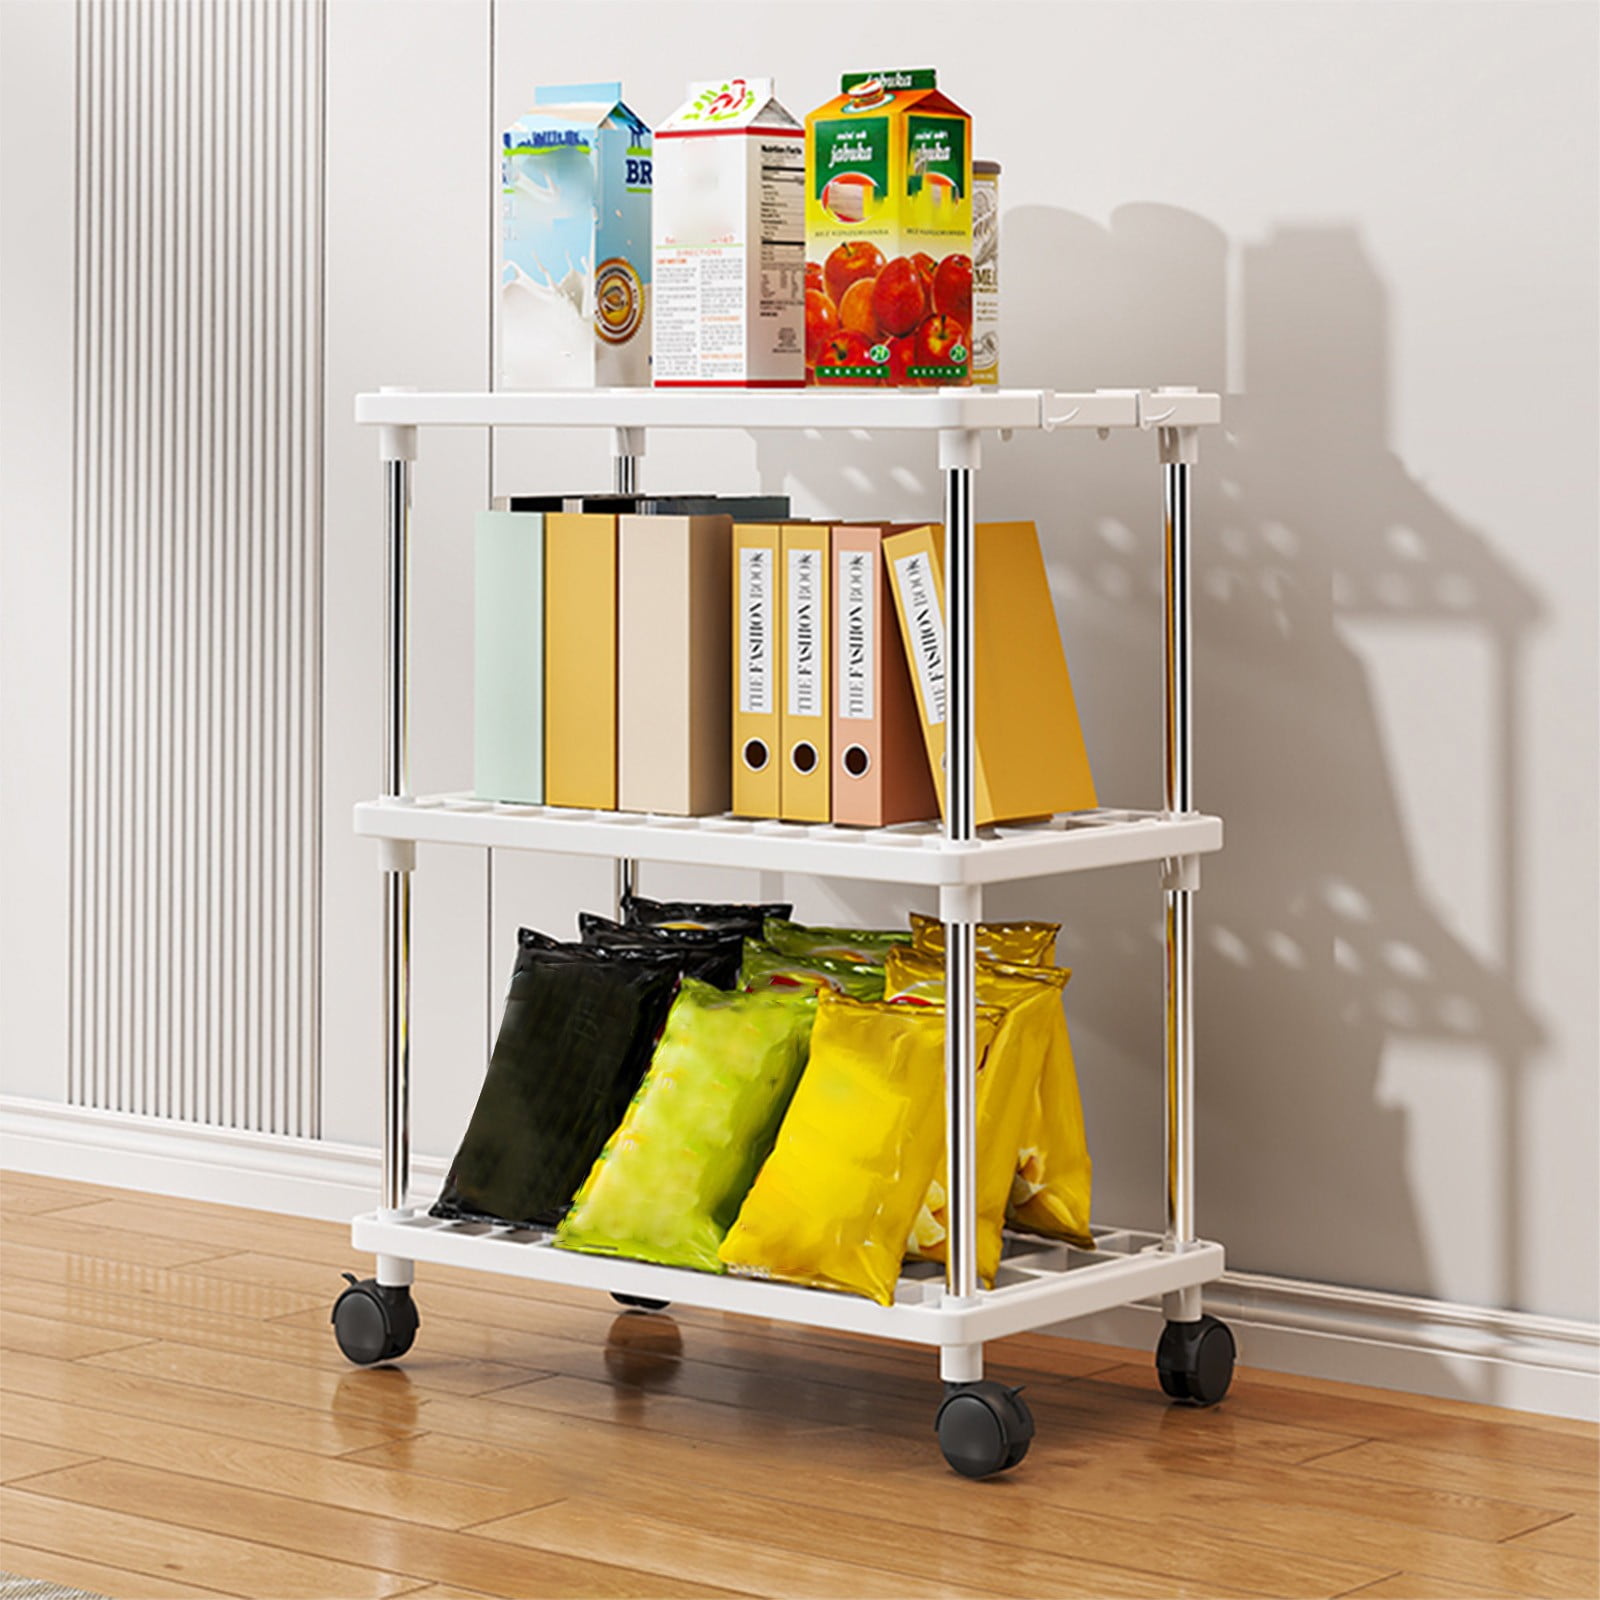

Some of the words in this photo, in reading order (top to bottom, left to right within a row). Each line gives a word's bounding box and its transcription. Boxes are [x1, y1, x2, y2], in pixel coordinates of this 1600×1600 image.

[867, 71, 913, 89] buka
[749, 551, 764, 599] BOOK
[798, 552, 812, 601] BOOK
[849, 554, 864, 603] BOOK
[905, 558, 929, 607] BOOK
[749, 602, 764, 673] FASHION
[798, 604, 812, 676] FASHION
[849, 606, 864, 678] FASHION
[916, 608, 945, 682] FASHION
[749, 674, 764, 711] THE
[798, 677, 812, 714] THE
[849, 680, 864, 717] THE
